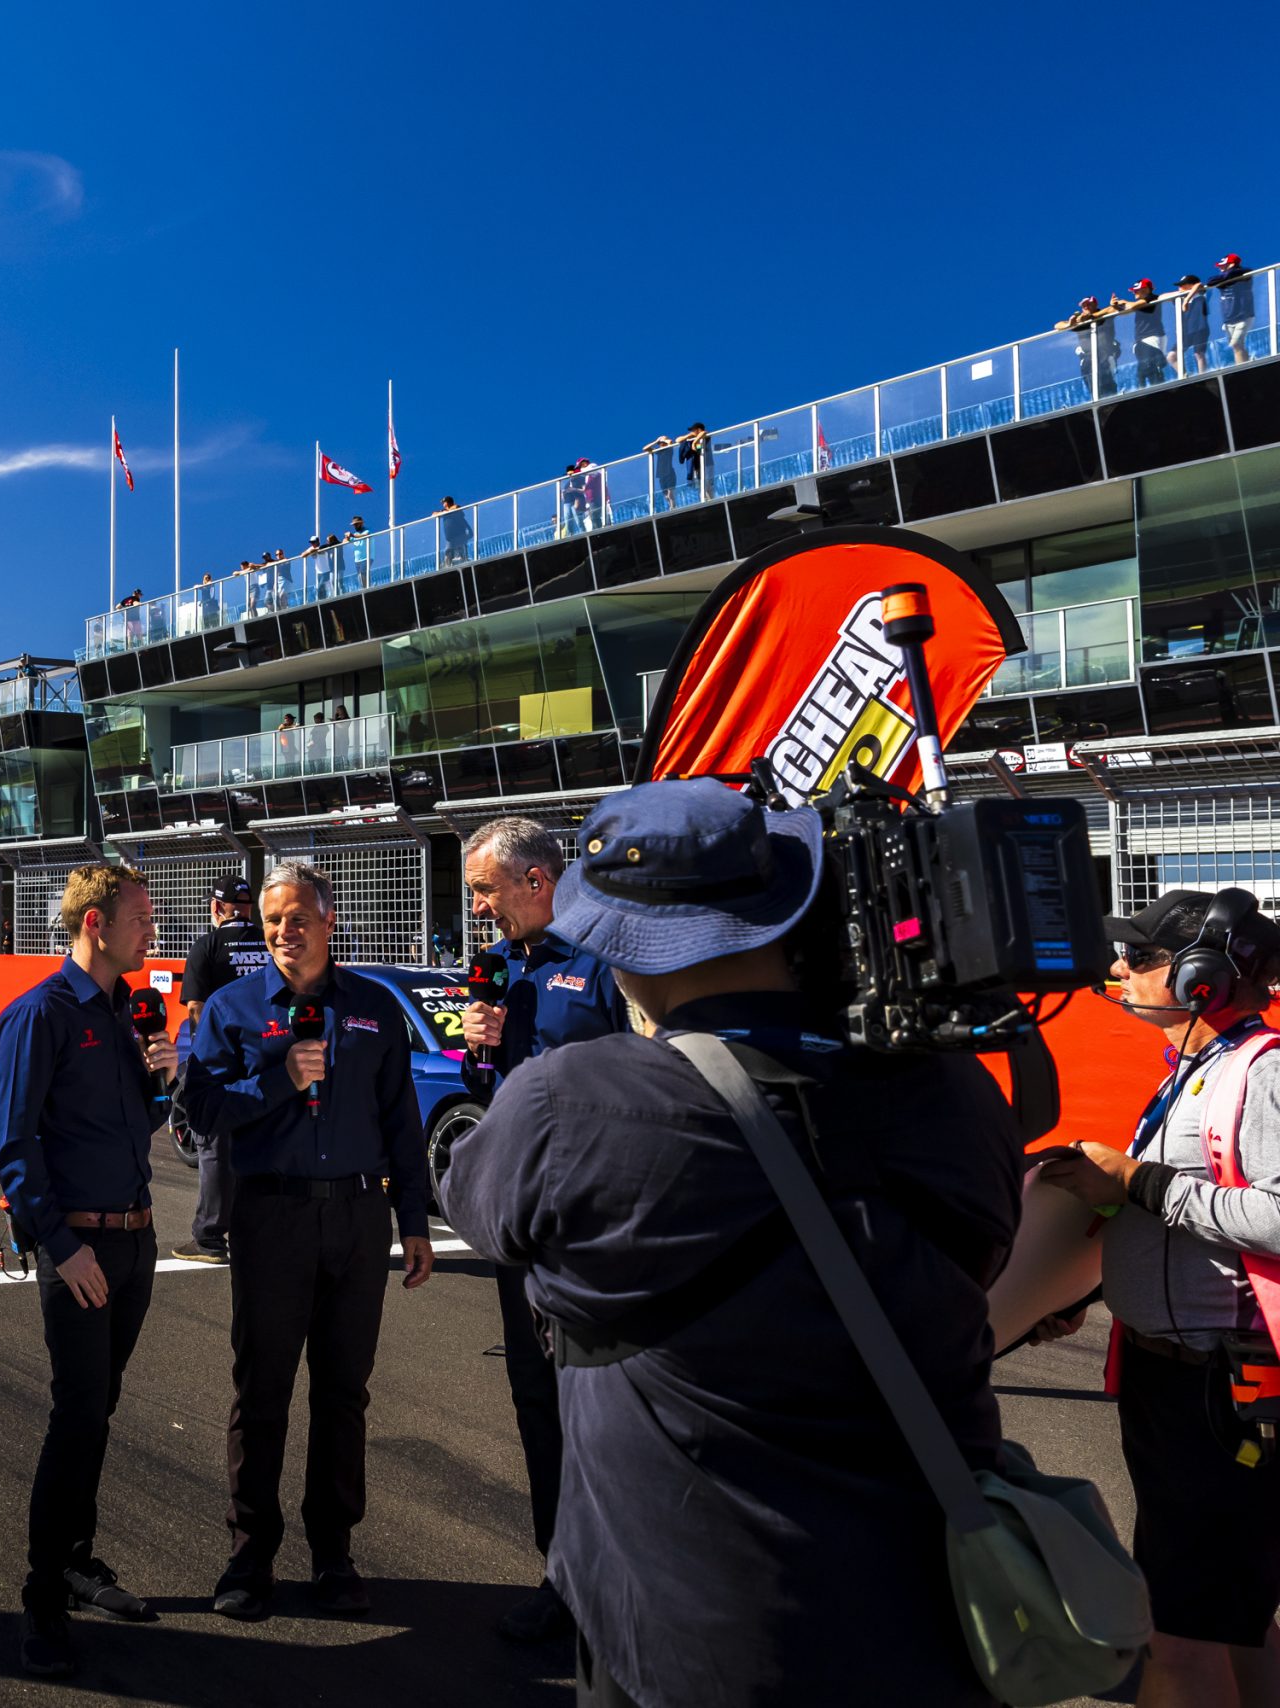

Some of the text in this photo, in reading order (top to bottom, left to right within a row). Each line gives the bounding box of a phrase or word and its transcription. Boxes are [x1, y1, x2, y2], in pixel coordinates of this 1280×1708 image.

[411, 987, 466, 1000] TCR
[1191, 983, 1211, 997] R
[433, 1011, 469, 1038] 2
[261, 1029, 290, 1039] SPORT
